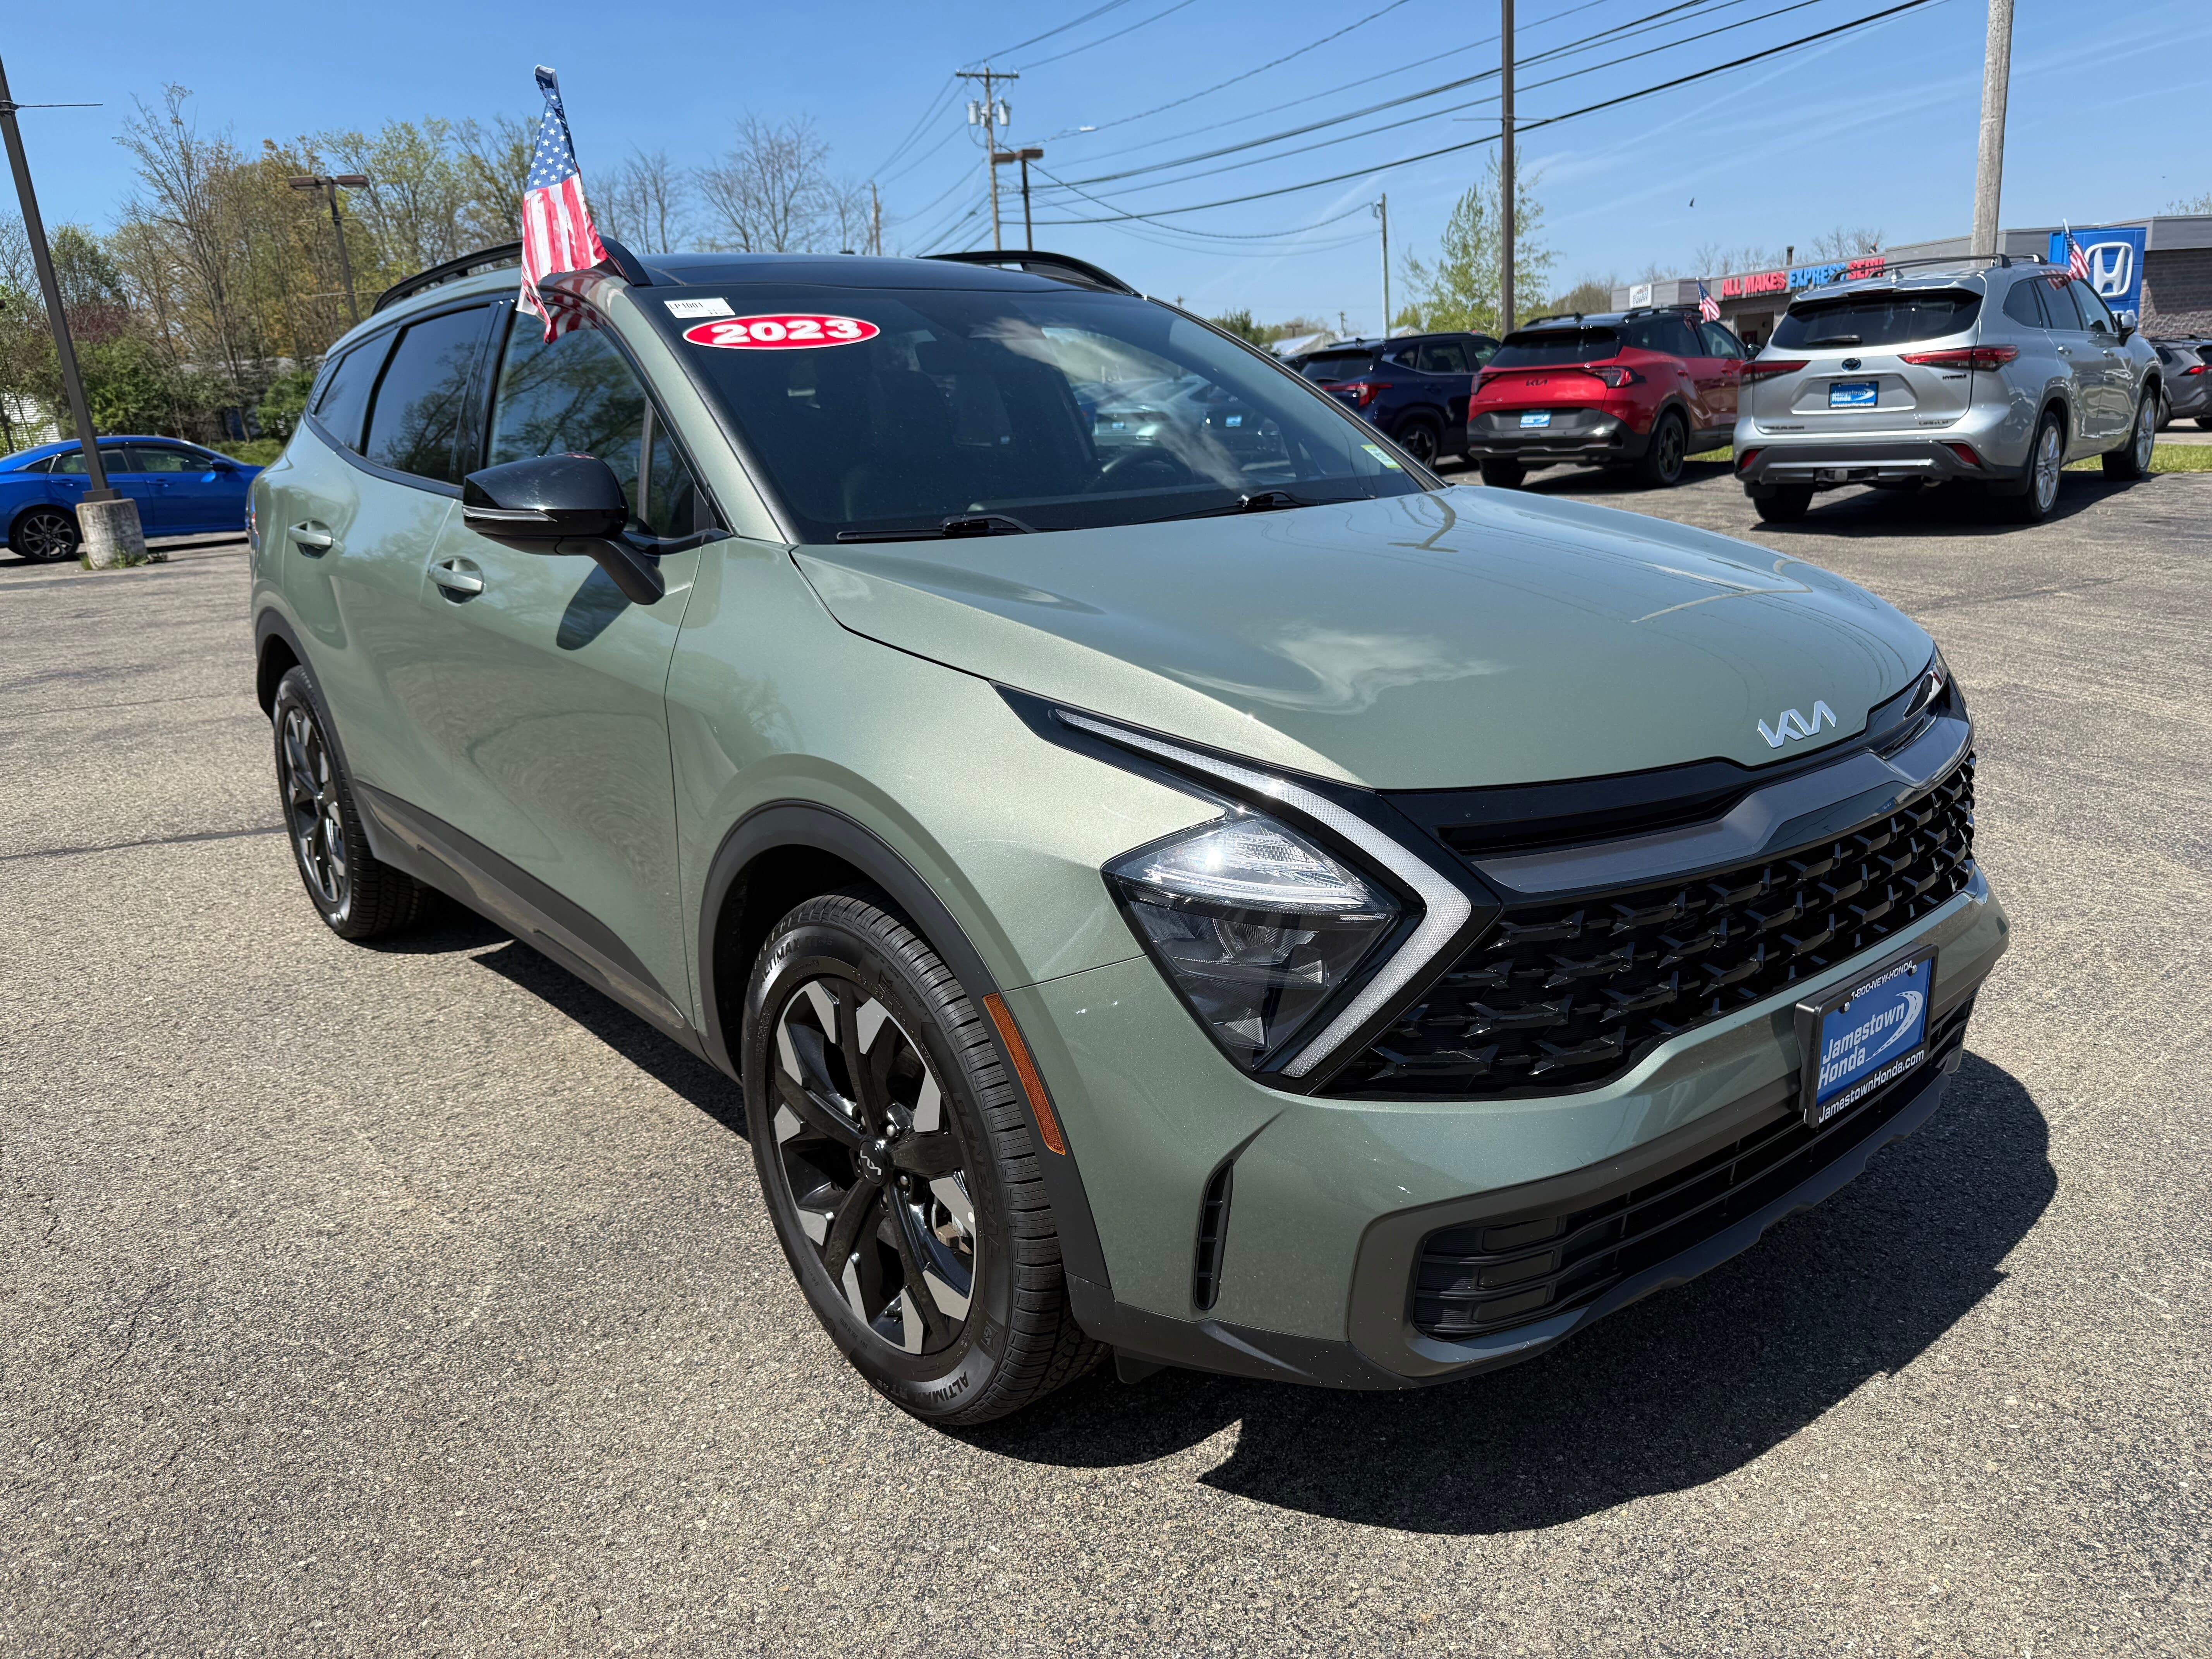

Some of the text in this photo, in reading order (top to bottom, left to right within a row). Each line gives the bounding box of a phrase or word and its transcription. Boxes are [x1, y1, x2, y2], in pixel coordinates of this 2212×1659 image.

[1721, 278, 1741, 296] ALL
[1744, 272, 1786, 294] MAKES
[711, 319, 862, 345] 2023
[1757, 700, 1836, 749] KIA
[1851, 960, 1912, 1000] 1-800-NEW-HONDA
[1822, 1003, 1905, 1065] Jamestown
[1818, 1046, 1865, 1090] Honda
[1818, 1049, 1924, 1124] JamestownHonda.com
